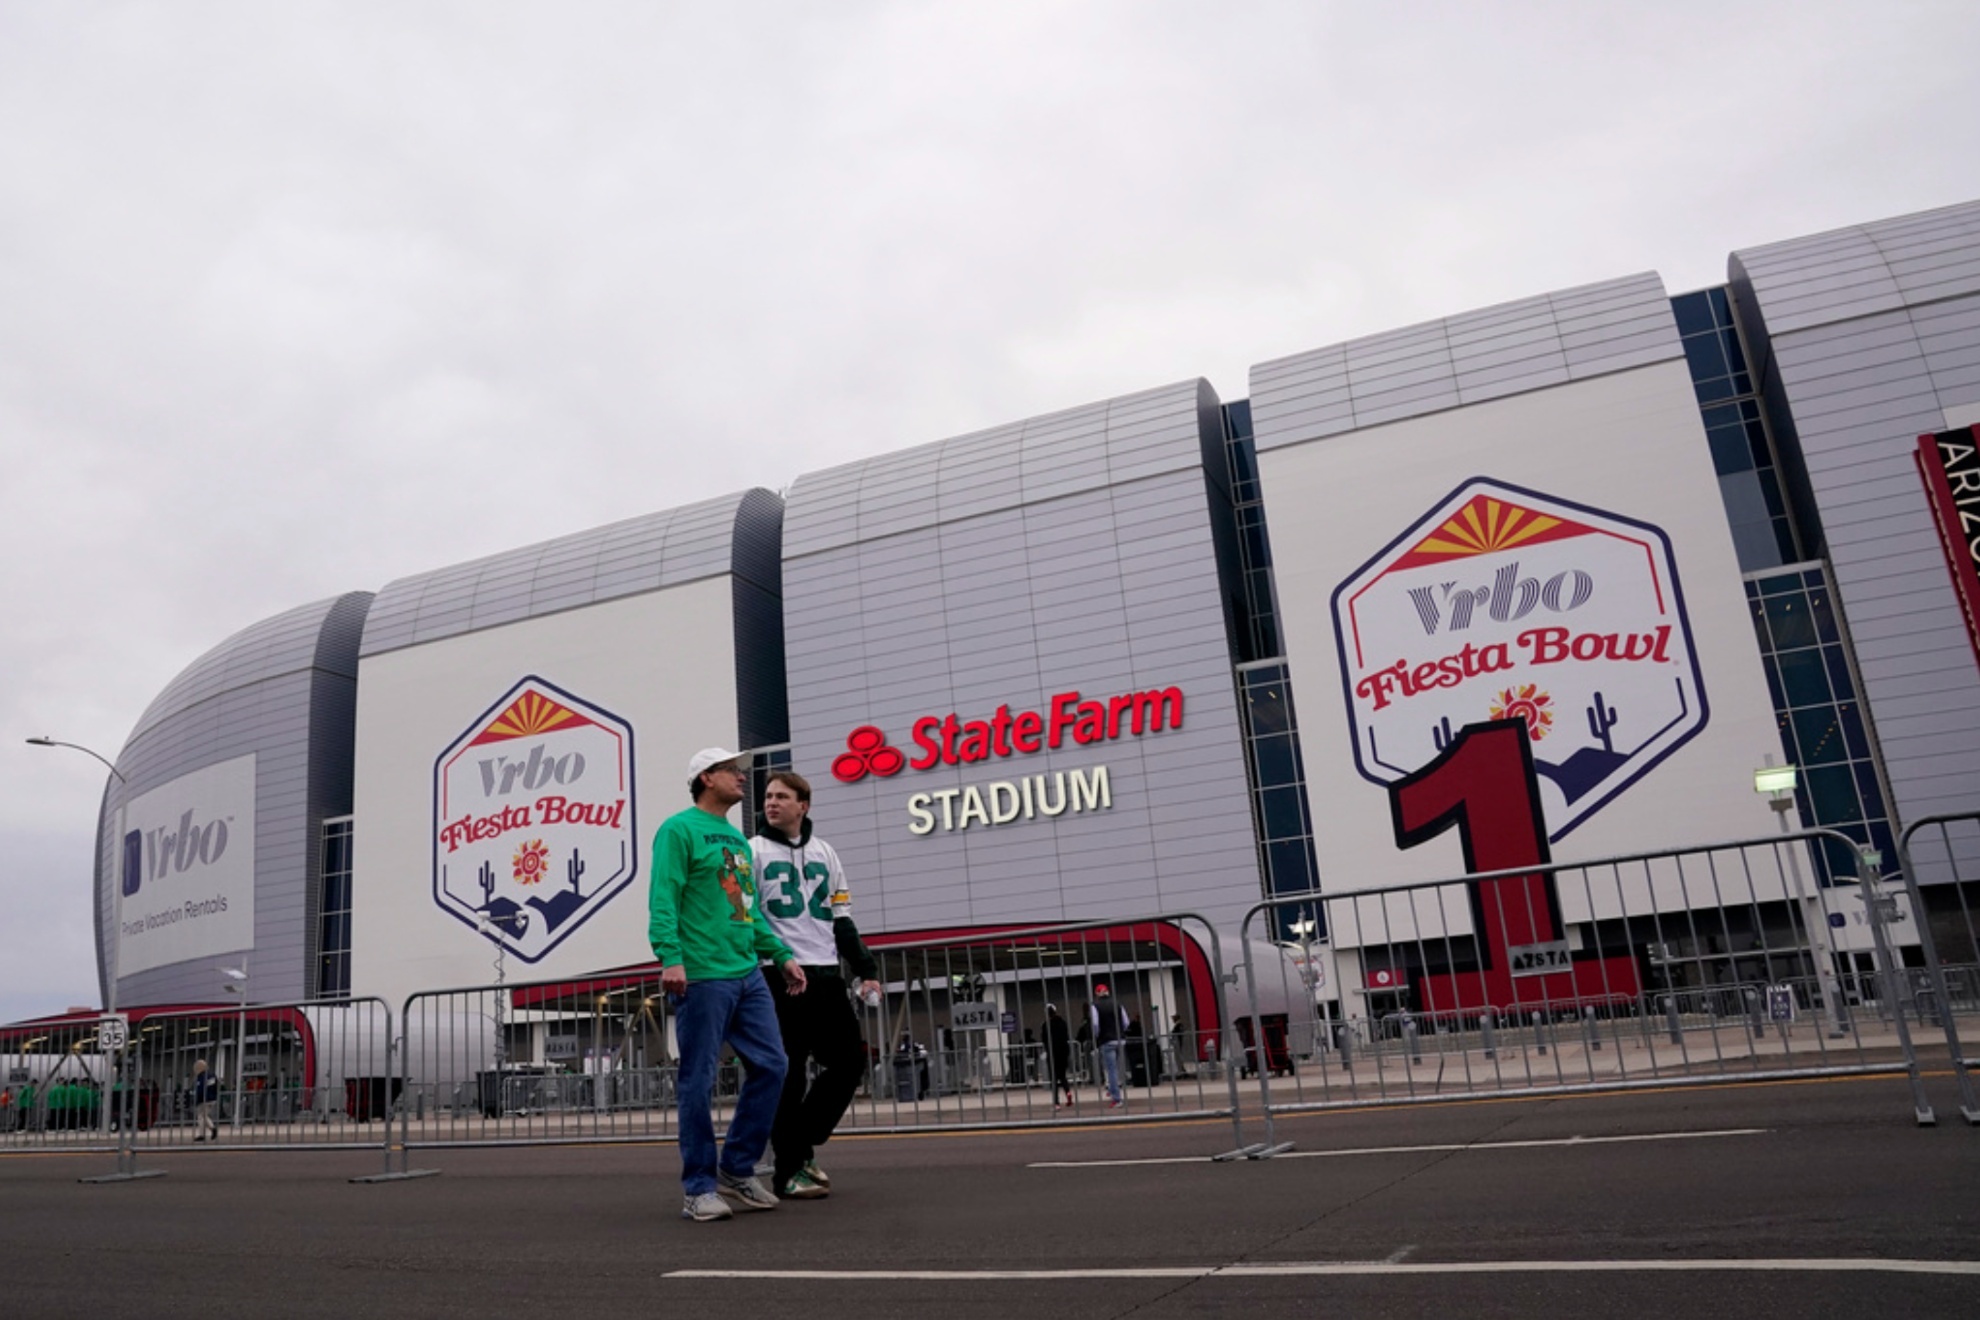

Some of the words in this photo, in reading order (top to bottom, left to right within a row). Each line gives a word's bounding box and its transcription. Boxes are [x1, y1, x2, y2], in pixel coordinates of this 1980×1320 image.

[1937, 441, 1980, 568] ARIZ
[1407, 561, 1593, 635] Vrbo
[1356, 642, 1514, 711] Fiesta
[1516, 624, 1672, 665] Bowl
[478, 743, 586, 797] Vrbo
[908, 765, 1112, 835] STADIUM
[146, 808, 228, 882] Vrbo
[439, 804, 532, 853] Fiesta
[535, 796, 625, 829] Bowl
[144, 905, 182, 931] Vacation
[184, 893, 227, 920] Rentals
[763, 861, 834, 922] 32
[103, 1032, 123, 1046] 35
